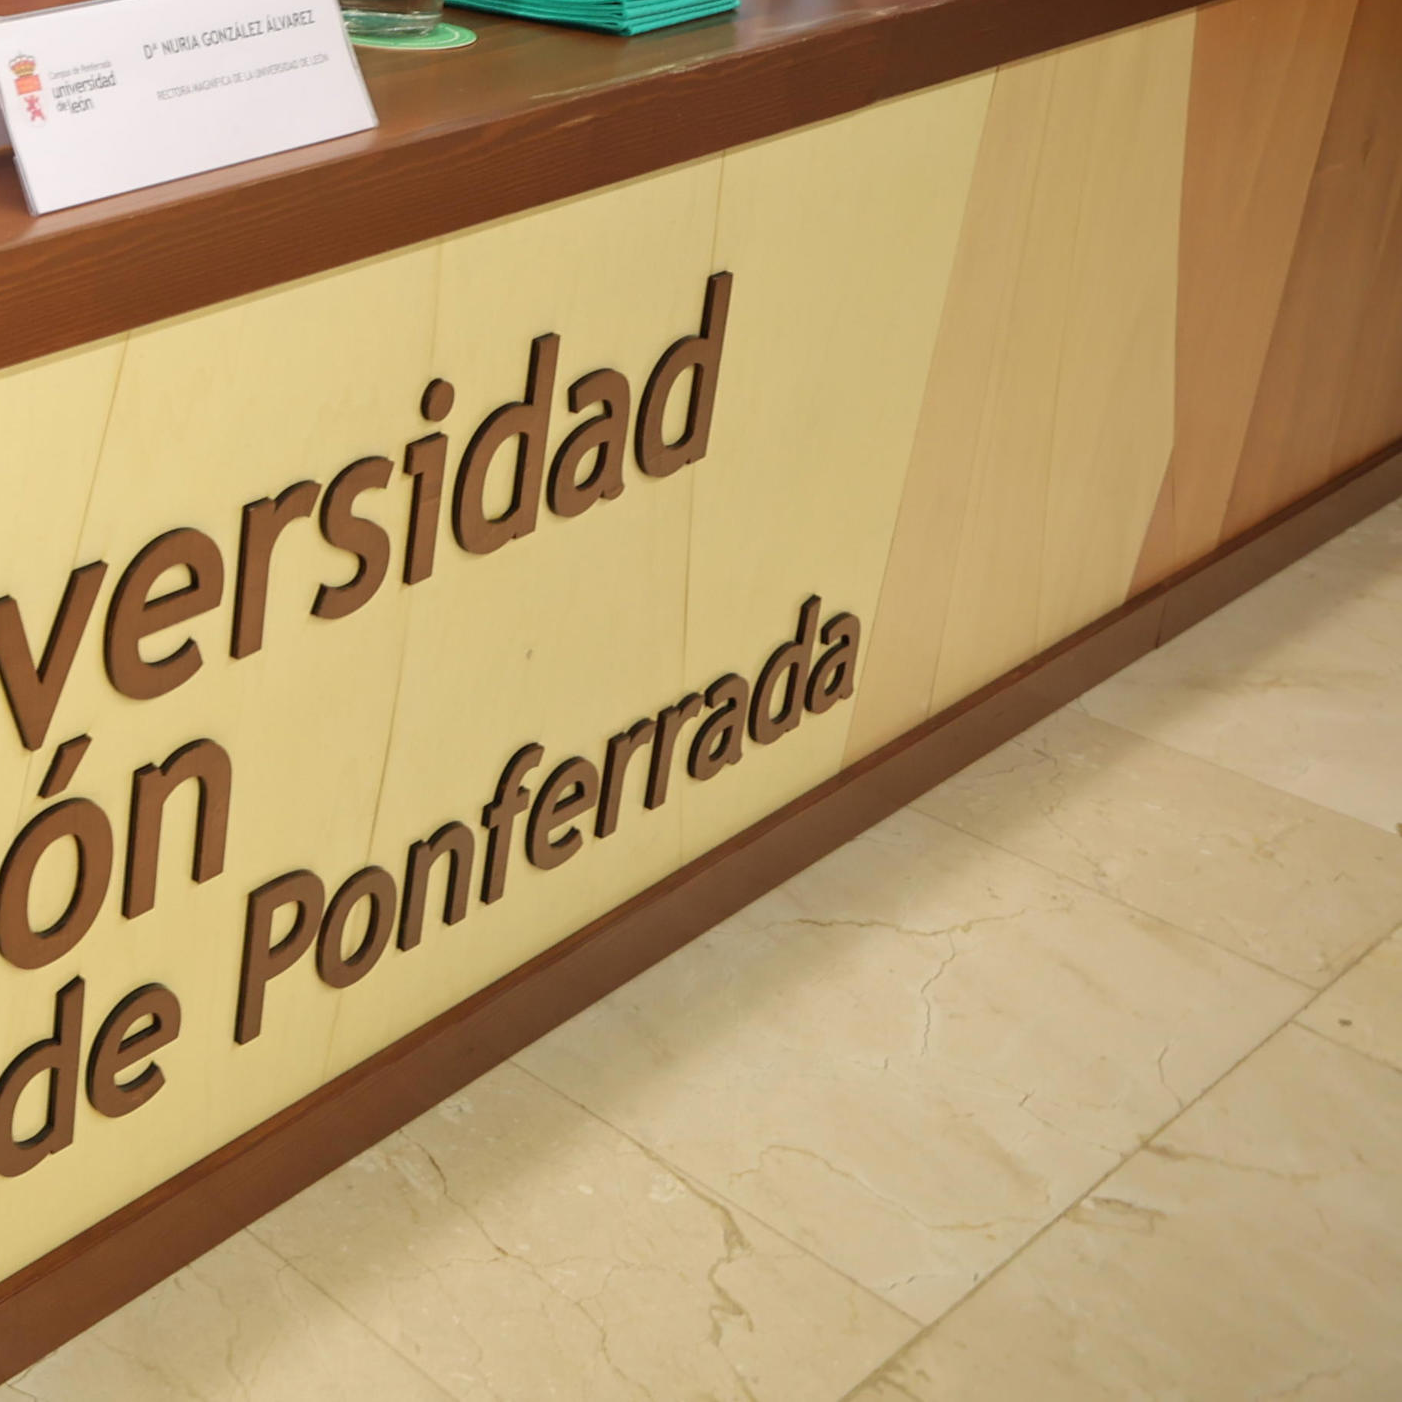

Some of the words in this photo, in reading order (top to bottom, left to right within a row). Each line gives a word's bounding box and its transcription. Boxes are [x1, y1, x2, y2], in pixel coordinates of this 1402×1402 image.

[143, 43, 158, 60] Dª
[161, 36, 200, 56] NURIA
[201, 21, 264, 47] GONZÁLEZ
[266, 9, 316, 33] ÁLVAREZ
[52, 70, 116, 99] universidad
[157, 85, 191, 101] RECTORA
[233, 73, 245, 84] DE
[246, 69, 254, 81] LA
[255, 60, 298, 79] UNIVERSIDAD
[300, 56, 309, 67] DE
[234, 594, 861, 1045] Ponferrada
